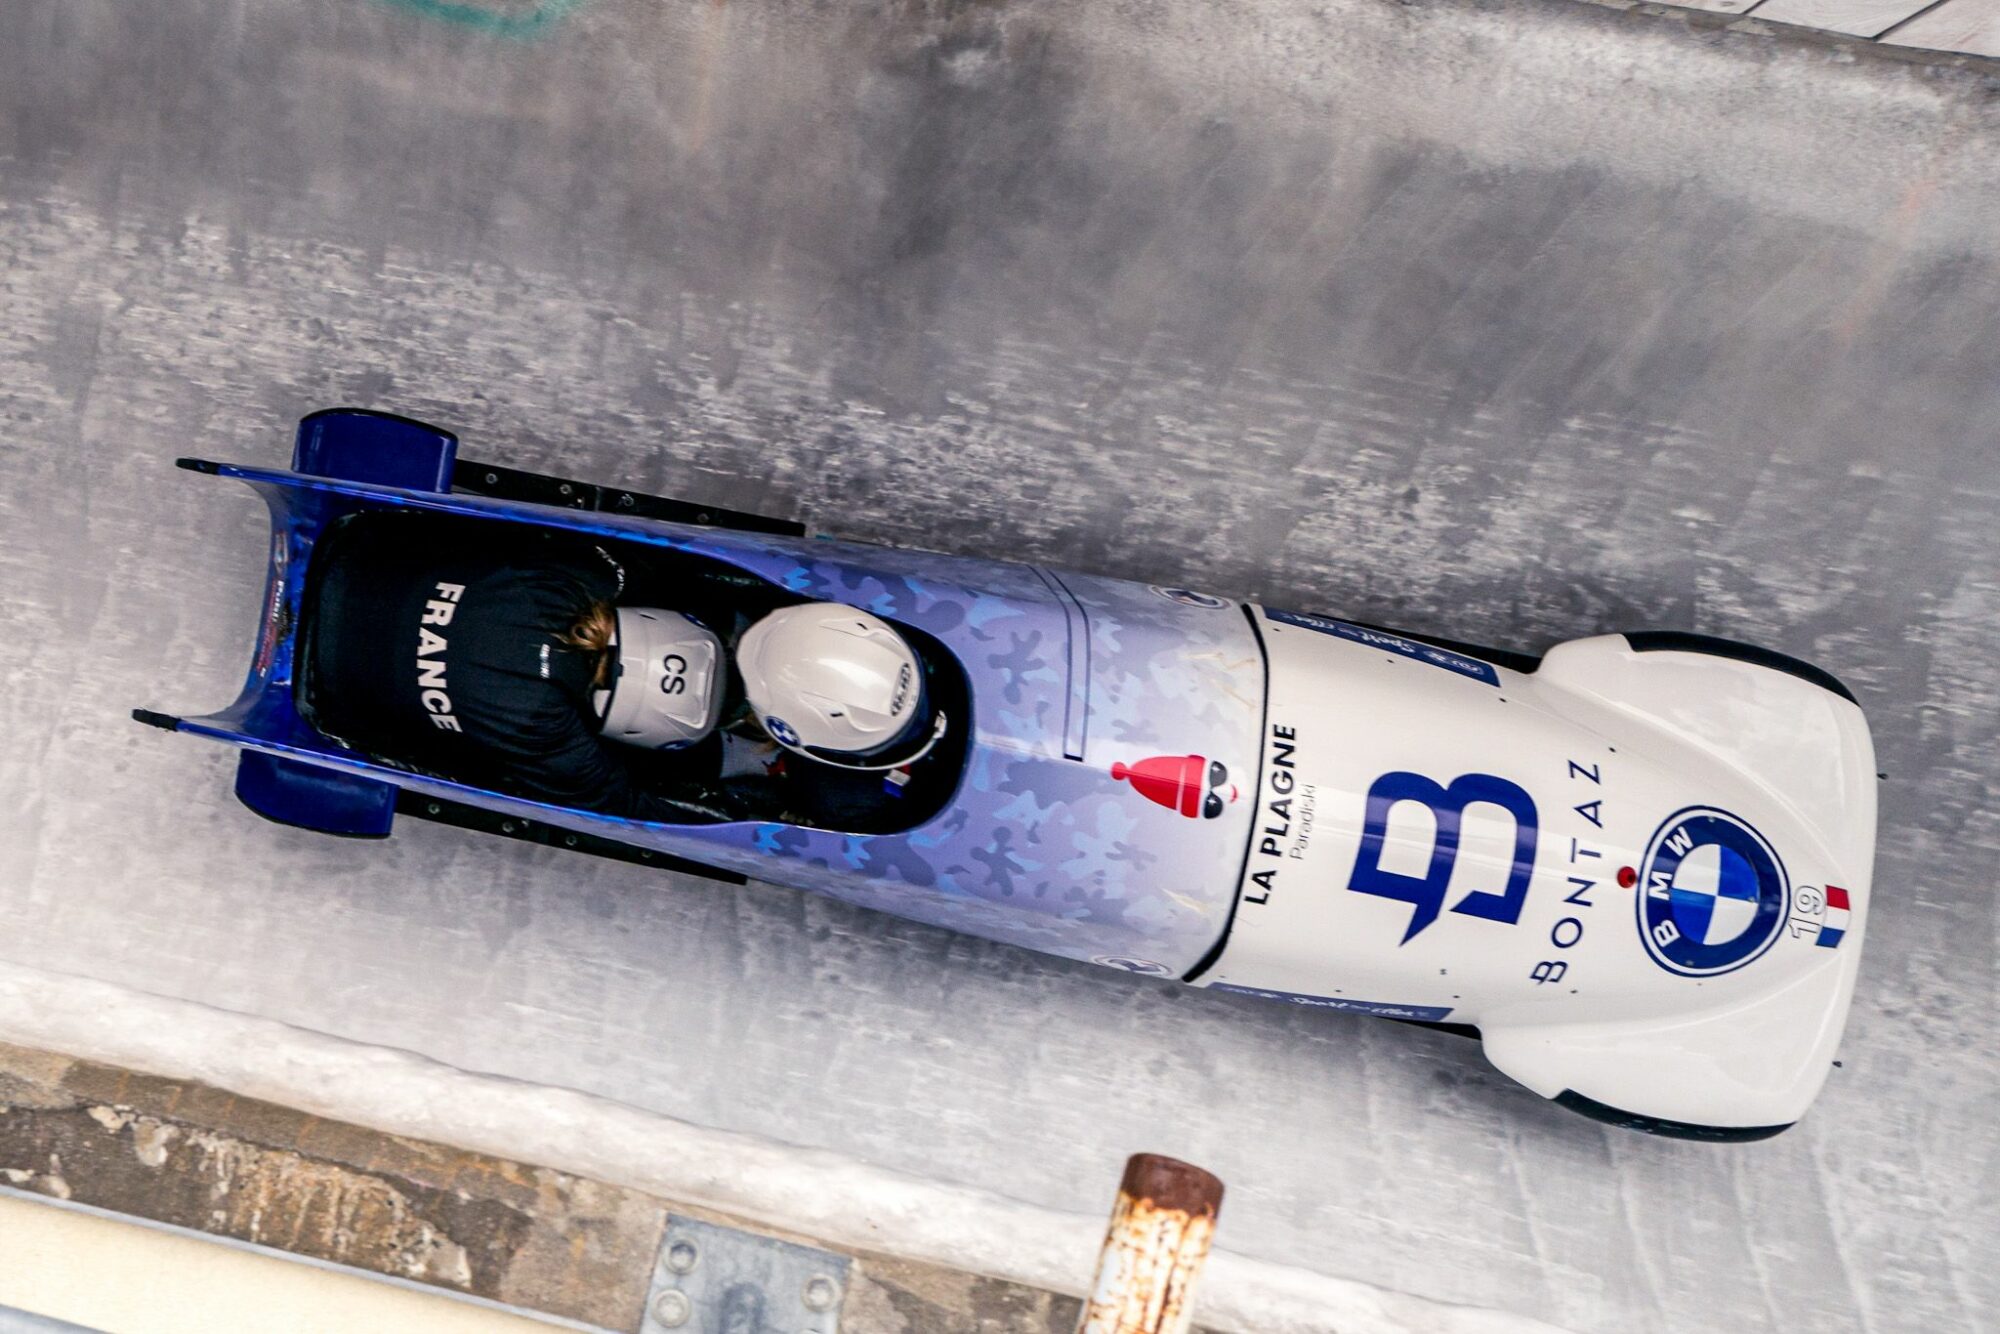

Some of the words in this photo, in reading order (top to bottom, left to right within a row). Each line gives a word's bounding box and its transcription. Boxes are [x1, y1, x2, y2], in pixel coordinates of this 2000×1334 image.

[416, 581, 466, 734] FRANCE
[660, 654, 687, 696] CS
[1258, 723, 1297, 859] PLAGNE
[1288, 783, 1317, 861] Paradiski
[1243, 868, 1278, 906] LA
[1528, 758, 1604, 986] BONTAZ
[1648, 825, 1695, 948] BMW
[1788, 884, 1828, 940] 19
